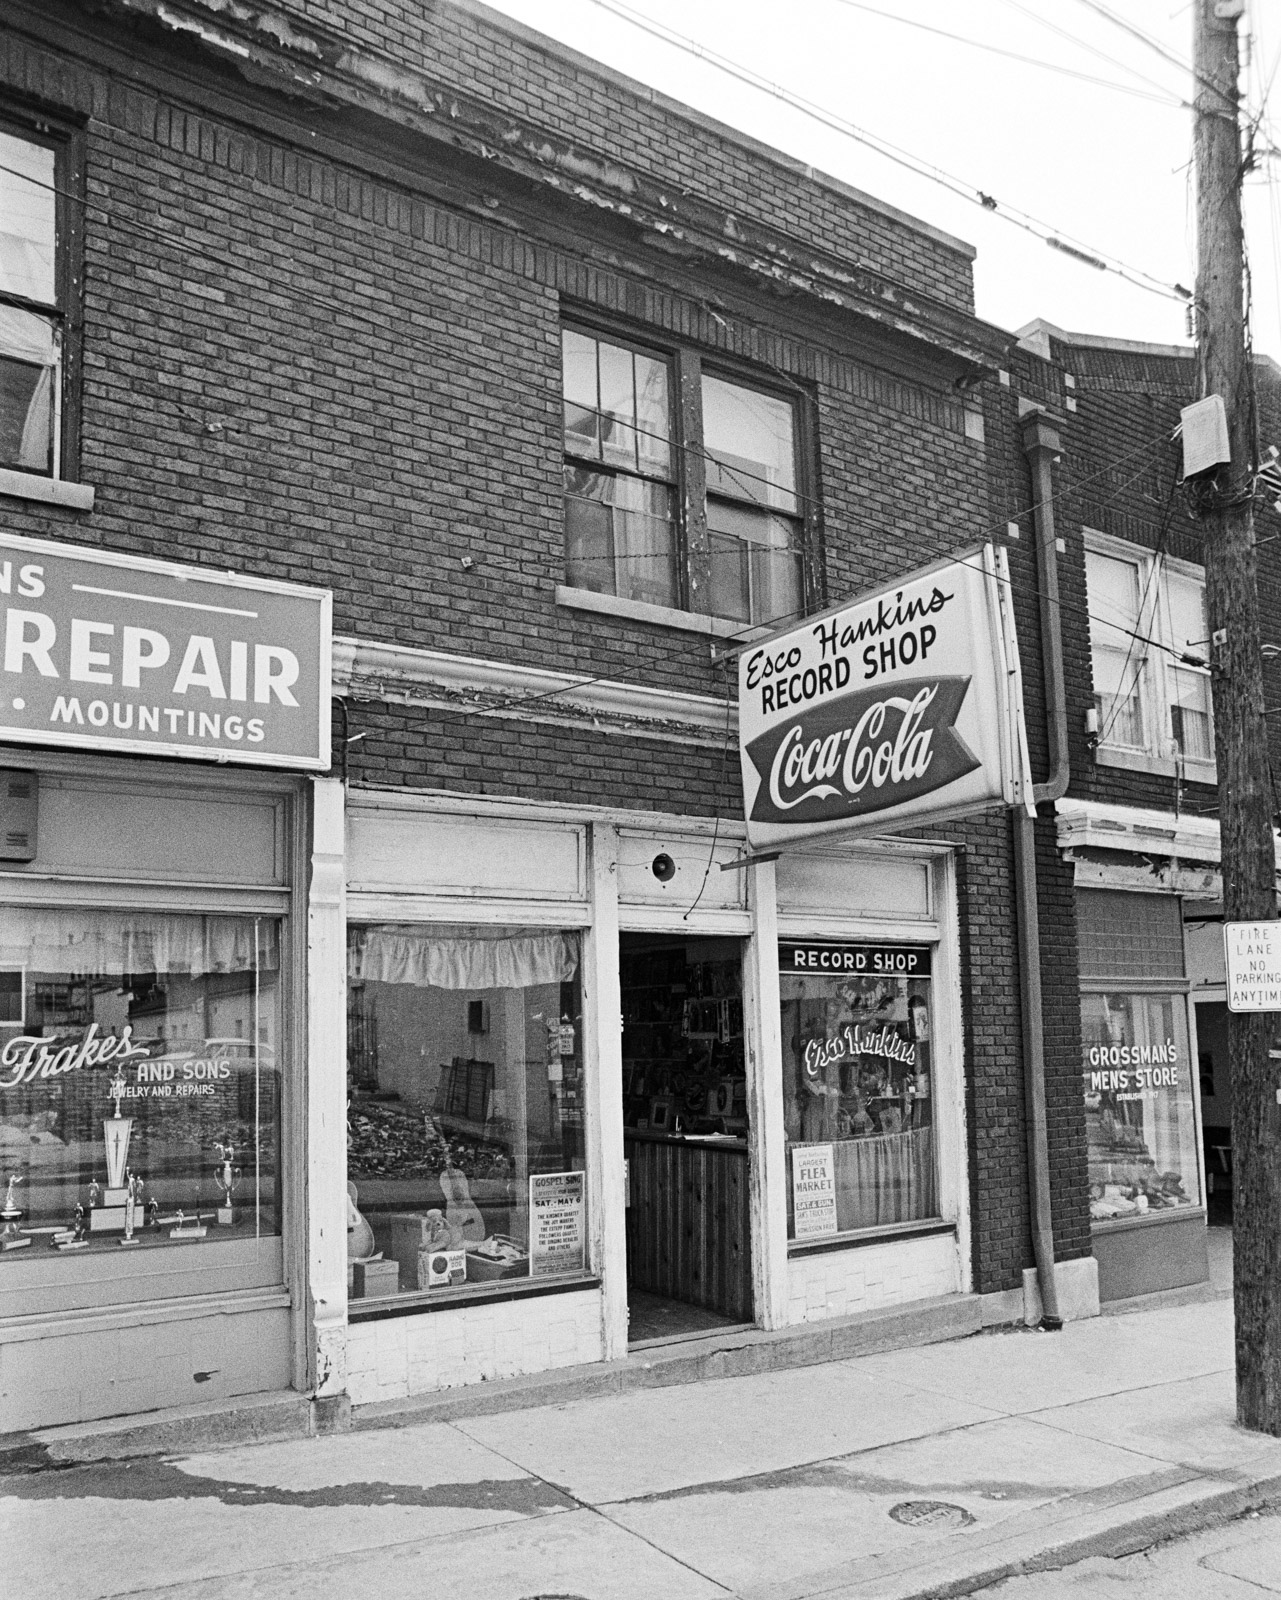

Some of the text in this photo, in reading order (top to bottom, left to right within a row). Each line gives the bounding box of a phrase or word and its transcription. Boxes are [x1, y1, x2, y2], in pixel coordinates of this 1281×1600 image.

[746, 587, 954, 690] Esco Hankins
[4, 608, 300, 707] REPAIR
[761, 624, 937, 714] RECORD SHOP
[50, 696, 265, 742] MOUNTINGS
[769, 682, 939, 810] Coca-Cola
[1240, 928, 1270, 940] FIRE
[794, 950, 918, 971] RECORD SHOP
[1237, 944, 1273, 956] LANE
[1249, 960, 1266, 972] NO
[1236, 973, 1281, 984] PARKING
[0, 1023, 150, 1087] Frakes
[804, 1025, 915, 1075] Esco Hankins
[1089, 1038, 1178, 1066] GROSSMAN'S
[137, 1061, 231, 1082] AND SONS
[1091, 1067, 1179, 1091] MENS STORE
[106, 1084, 215, 1099] JEWELRY AND REPAIRS
[799, 1158, 827, 1167] LARGEST
[535, 1175, 581, 1187] GOSPEL SING
[800, 1167, 827, 1180] FLEA
[796, 1180, 832, 1192] MARKET
[576, 1196, 581, 1204] 6
